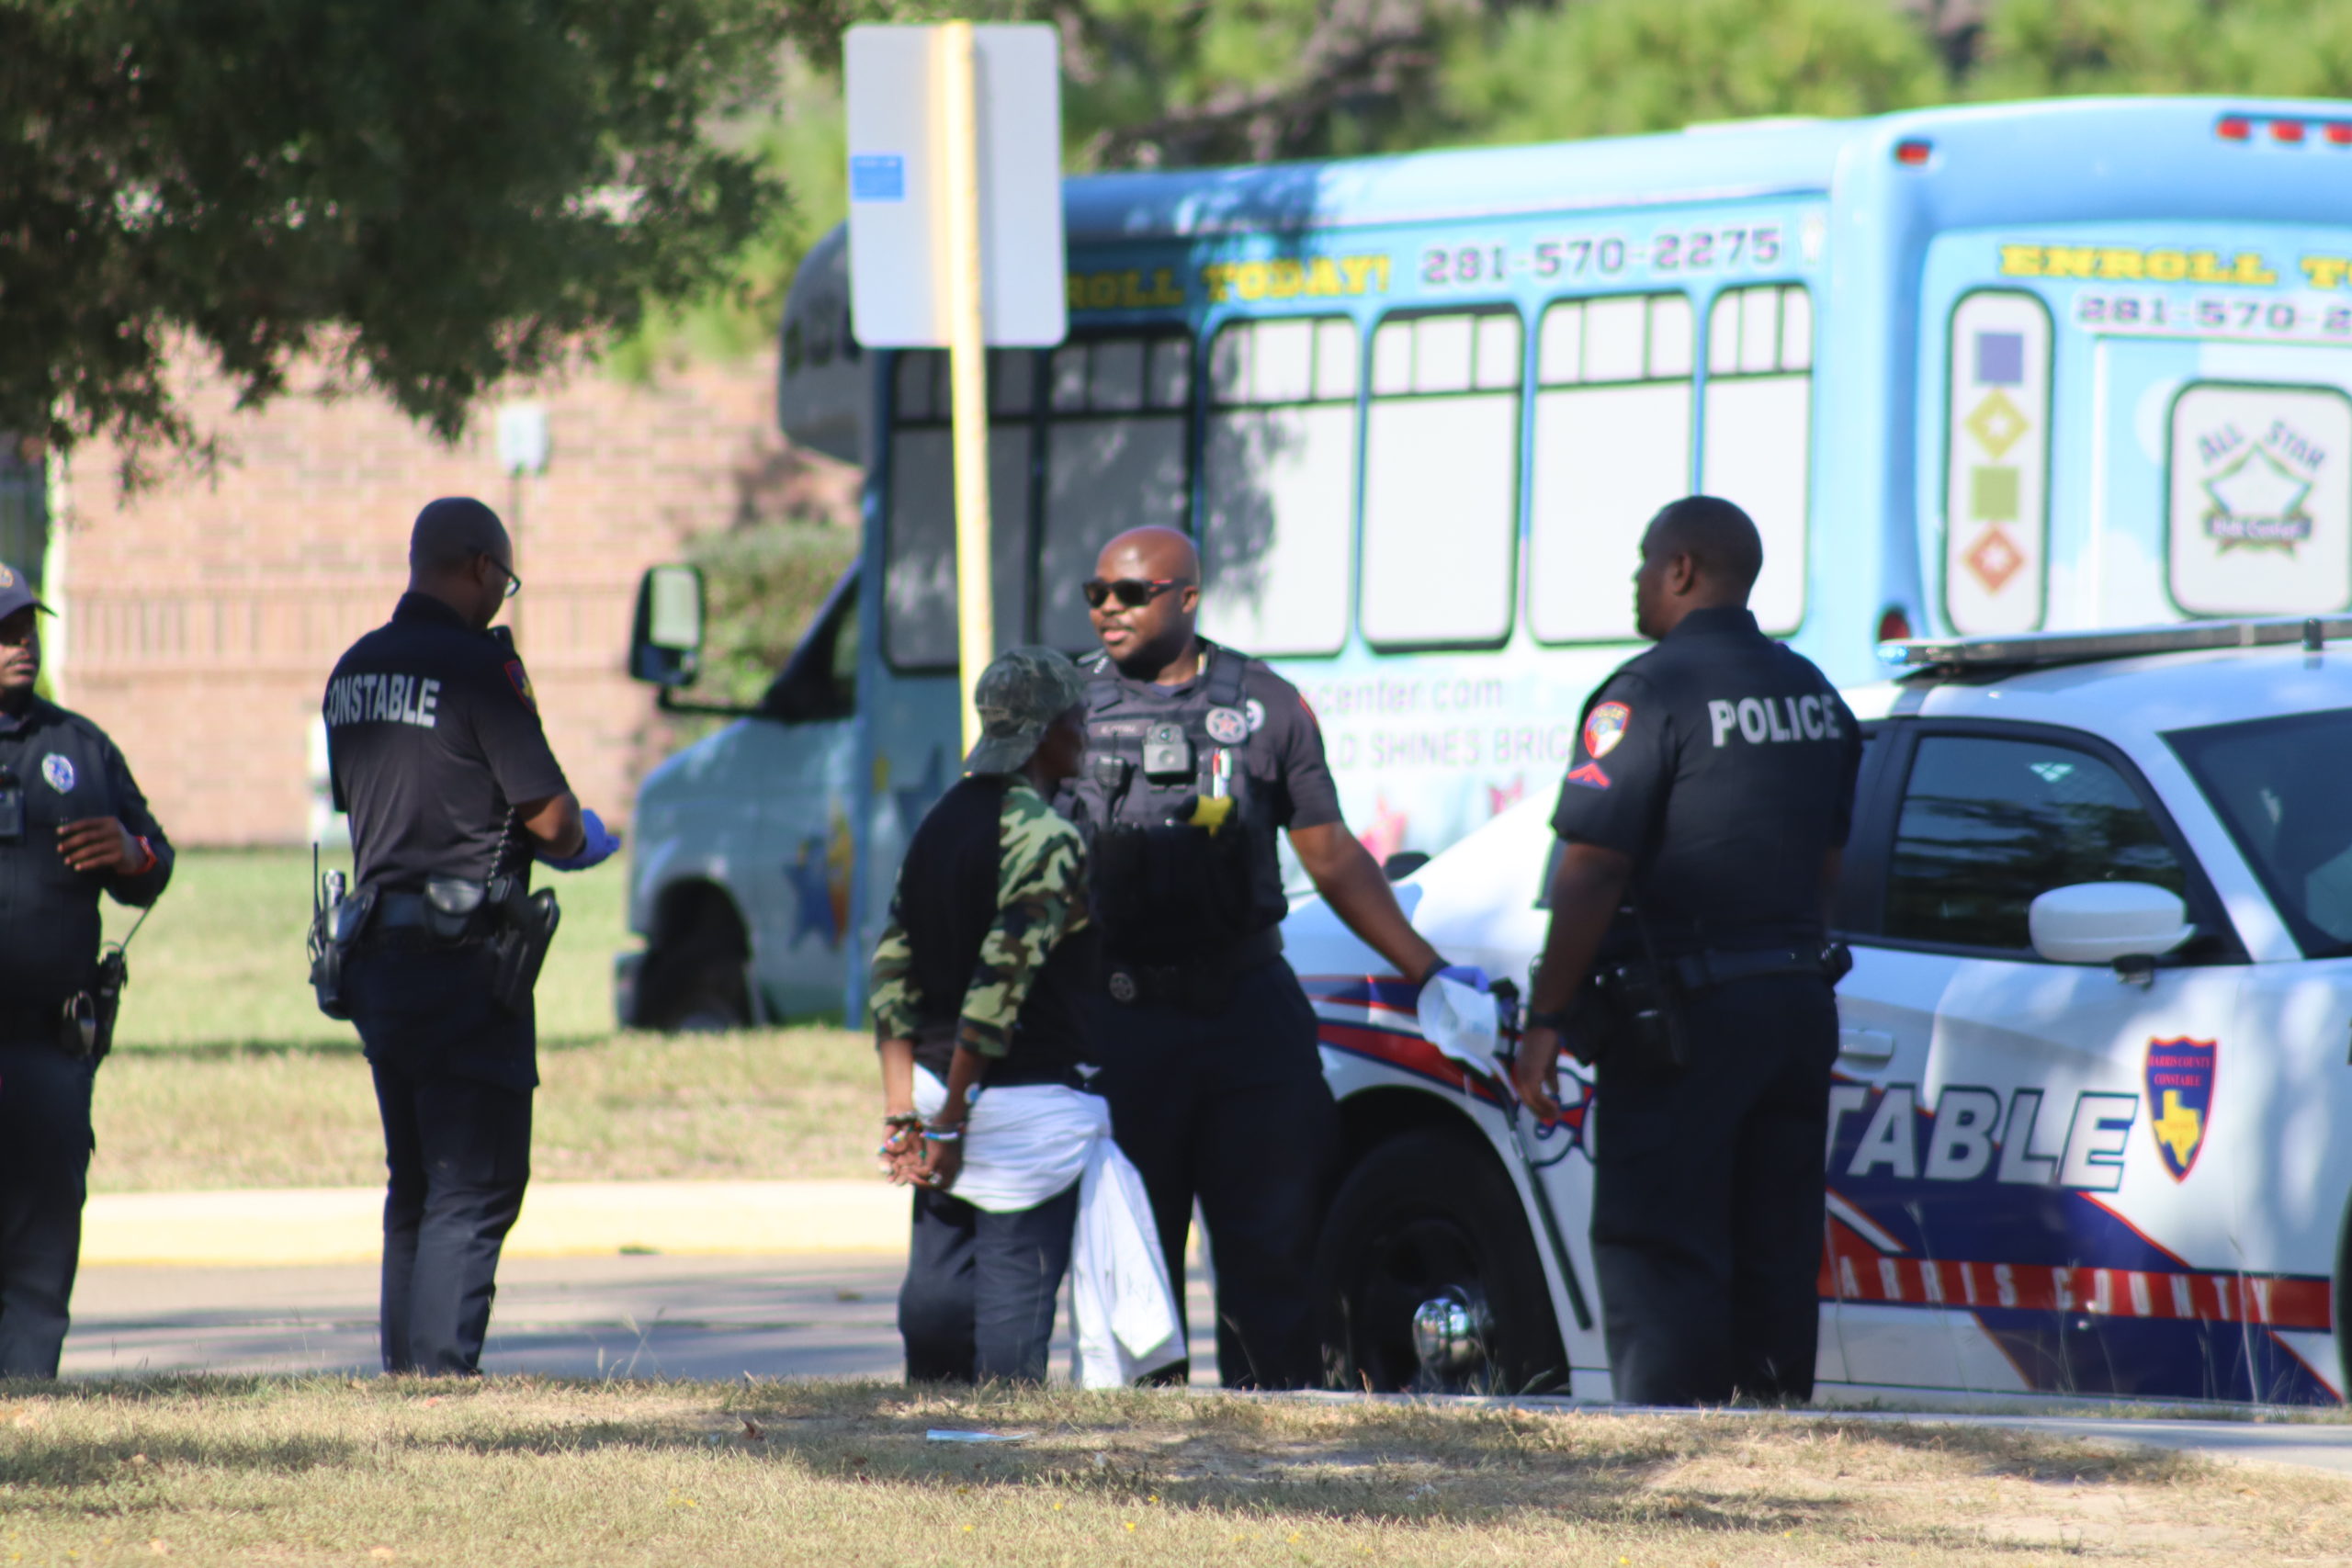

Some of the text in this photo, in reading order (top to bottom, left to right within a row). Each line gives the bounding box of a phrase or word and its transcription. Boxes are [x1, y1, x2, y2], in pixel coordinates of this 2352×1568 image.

[1067, 256, 1390, 310] ROLL TODAY!
[1421, 227, 1781, 286] 281-570-2275
[2000, 246, 2278, 287] ENROLL
[327, 673, 441, 728] ONSTABLE
[1707, 694, 1840, 749] POLICE
[1370, 727, 1483, 768] SHINES
[2154, 1073, 2202, 1088] CONSTABLE
[1838, 1255, 2018, 1309] ARRIS
